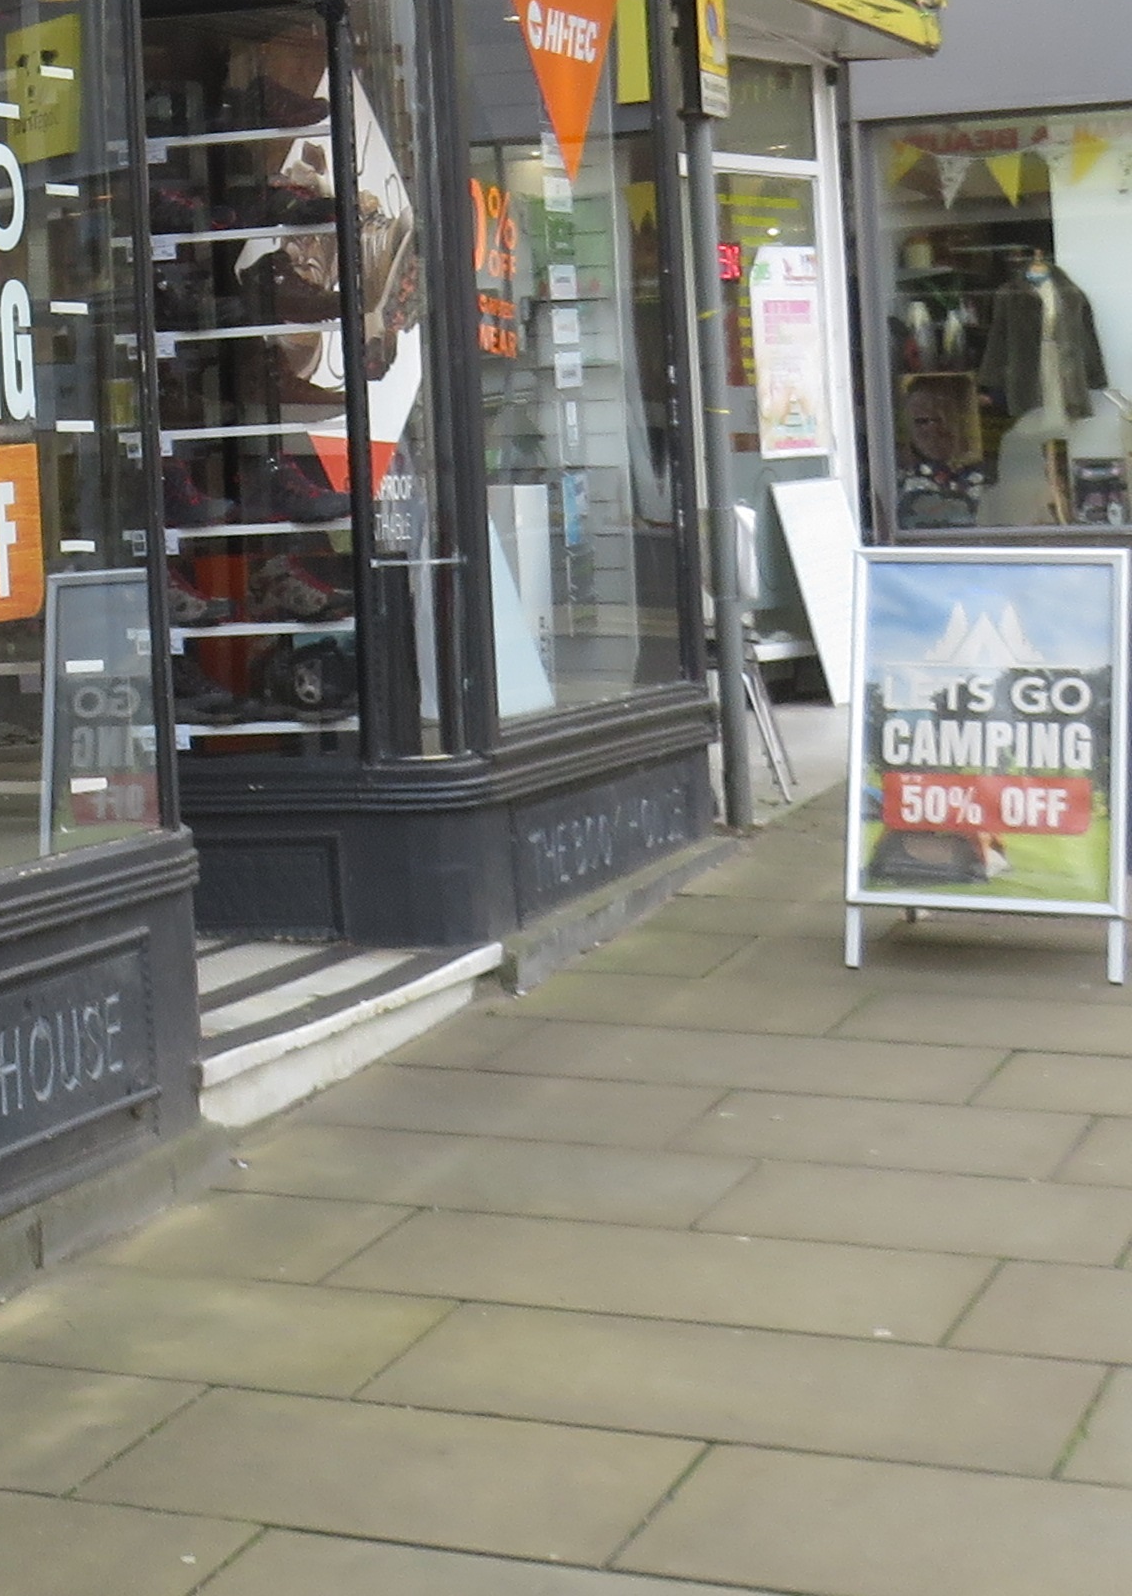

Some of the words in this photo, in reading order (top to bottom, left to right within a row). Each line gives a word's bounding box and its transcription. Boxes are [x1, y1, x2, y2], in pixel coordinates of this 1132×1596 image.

[544, 7, 598, 63] HI-TEC
[883, 674, 996, 712] LETS
[1011, 676, 1093, 714] GO
[882, 718, 1093, 770] CAMPING
[901, 784, 982, 825] 50%
[1001, 786, 1067, 827] OFF
